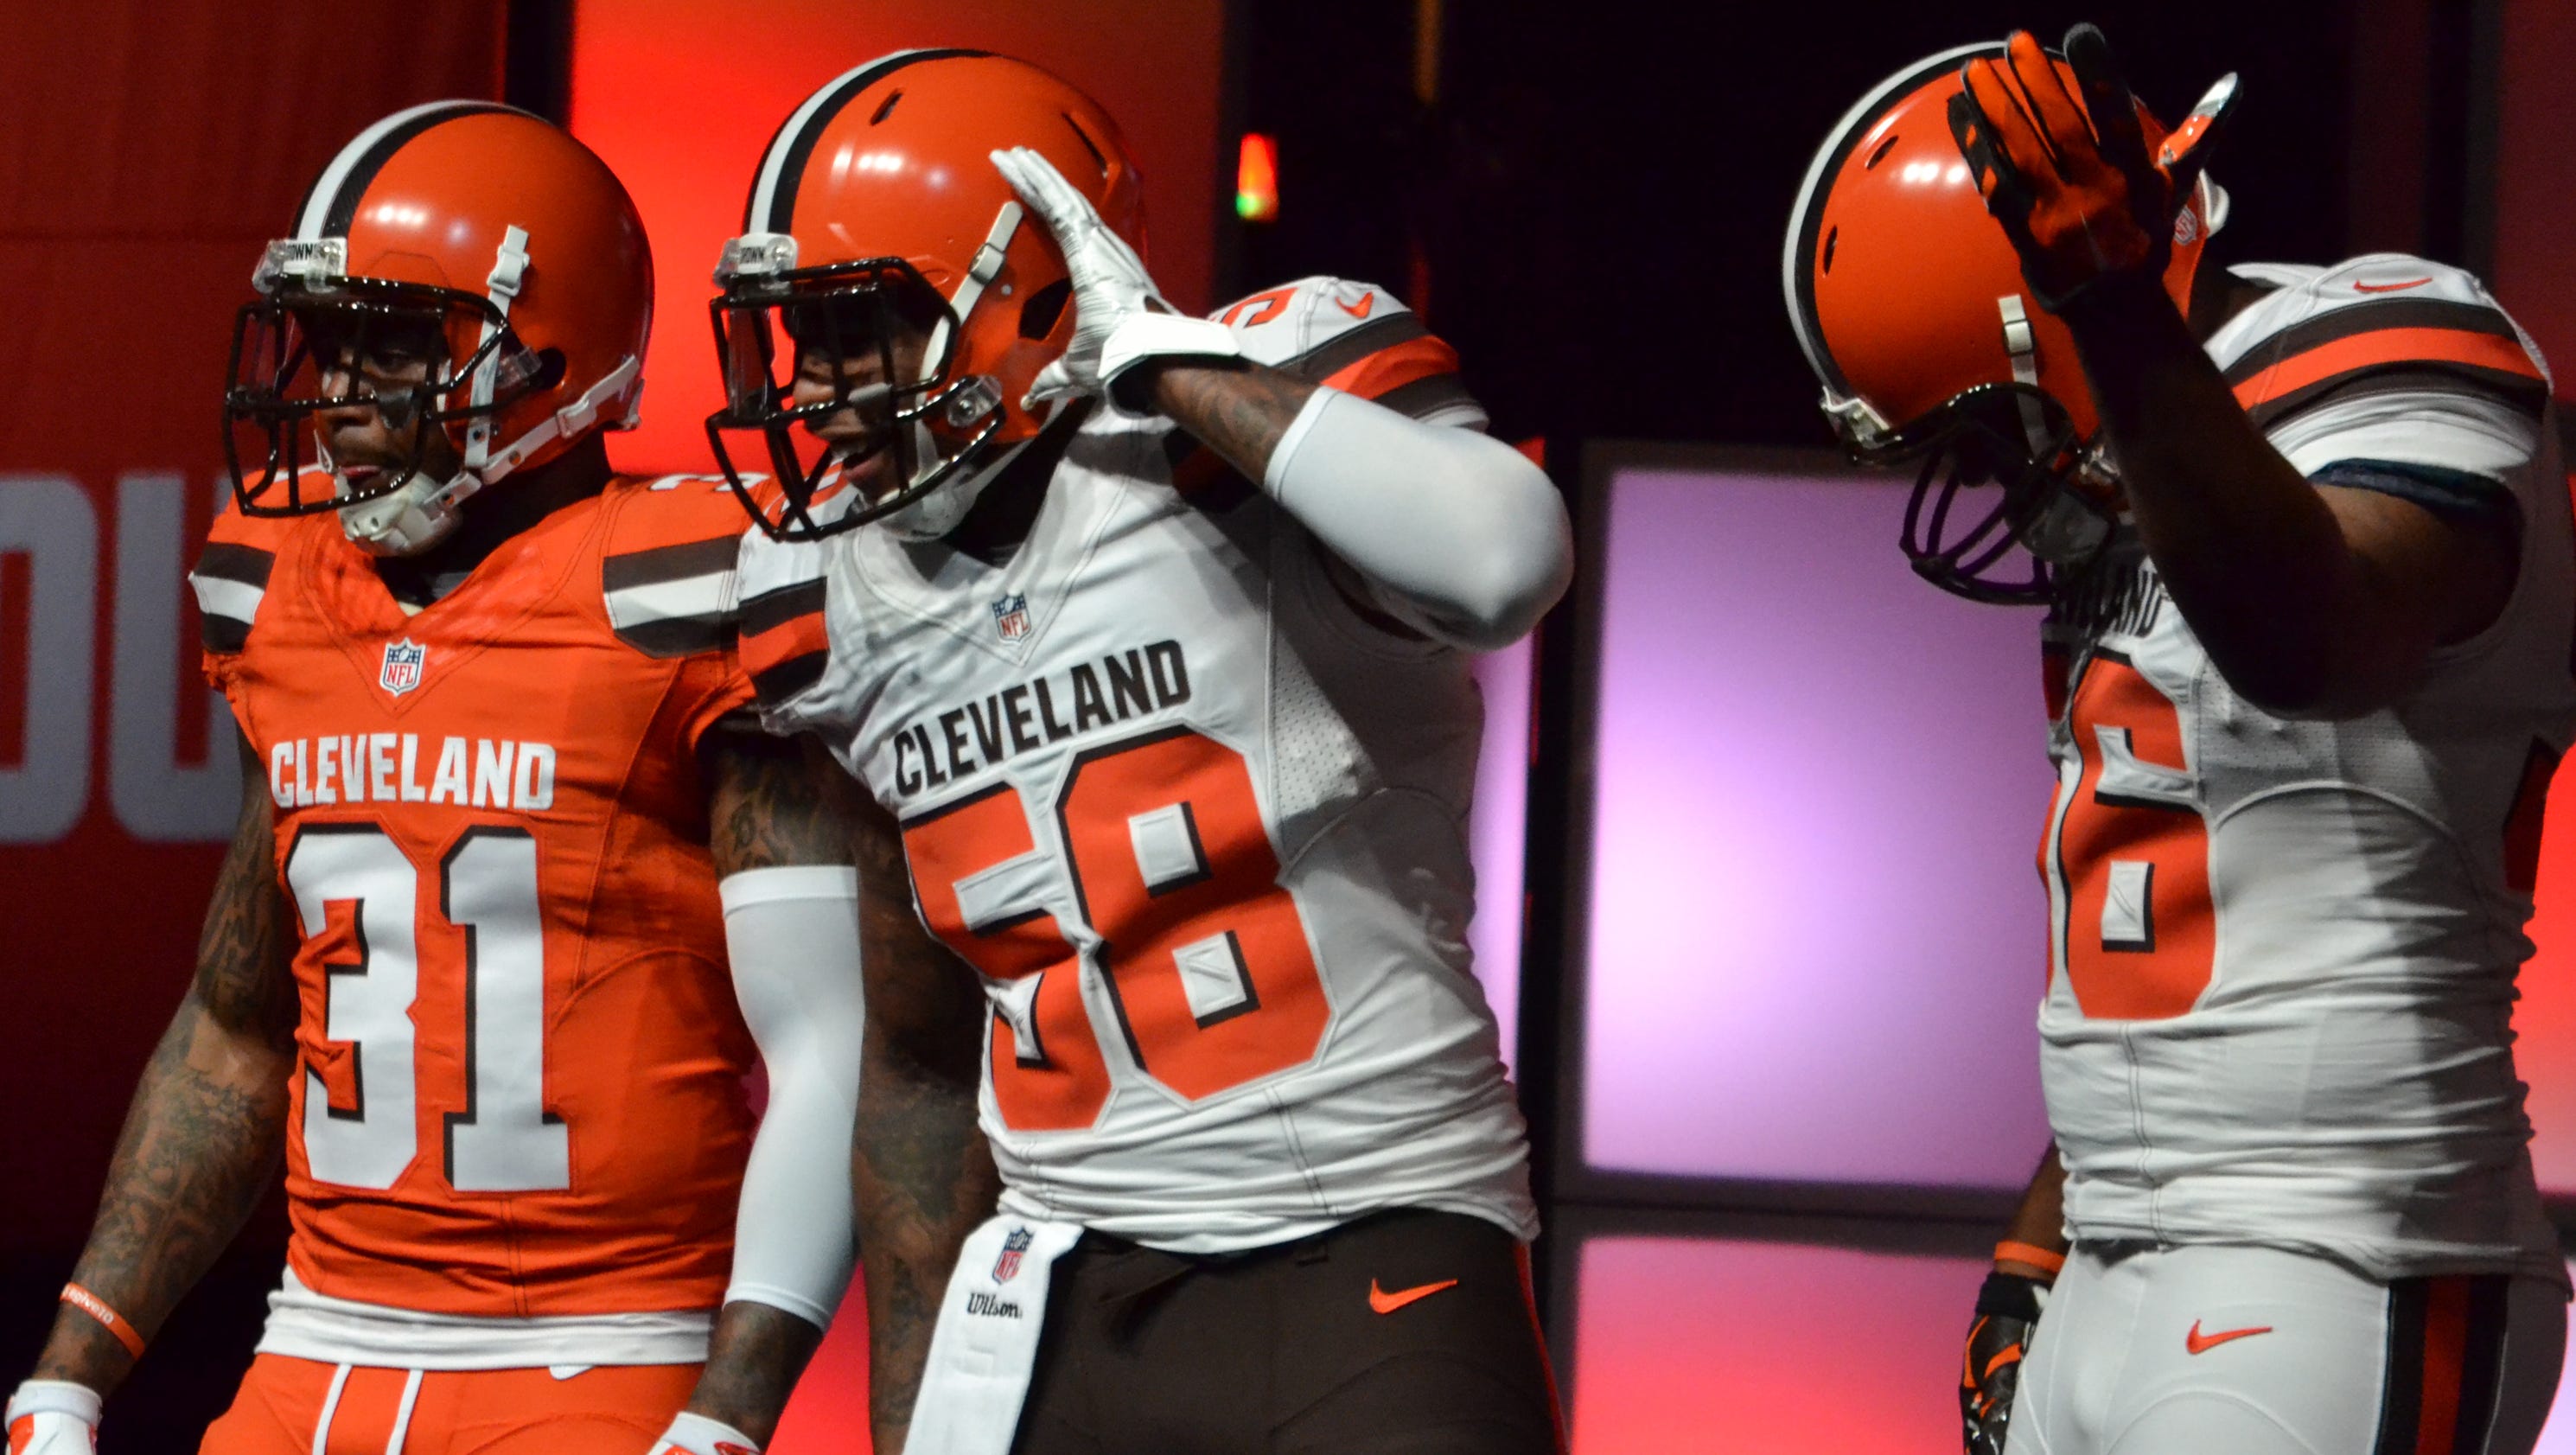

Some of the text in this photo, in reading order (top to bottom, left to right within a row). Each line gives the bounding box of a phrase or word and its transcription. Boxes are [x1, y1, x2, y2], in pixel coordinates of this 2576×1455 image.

[999, 611, 1030, 636] NFL
[386, 664, 415, 686] NFL
[894, 639, 1191, 797] CLEVELAND
[271, 732, 557, 811] CLEVELAND
[900, 723, 1332, 1131] 58
[284, 822, 571, 1192] 31
[994, 1251, 1023, 1281] NFL
[967, 1292, 1019, 1319] Wilson
